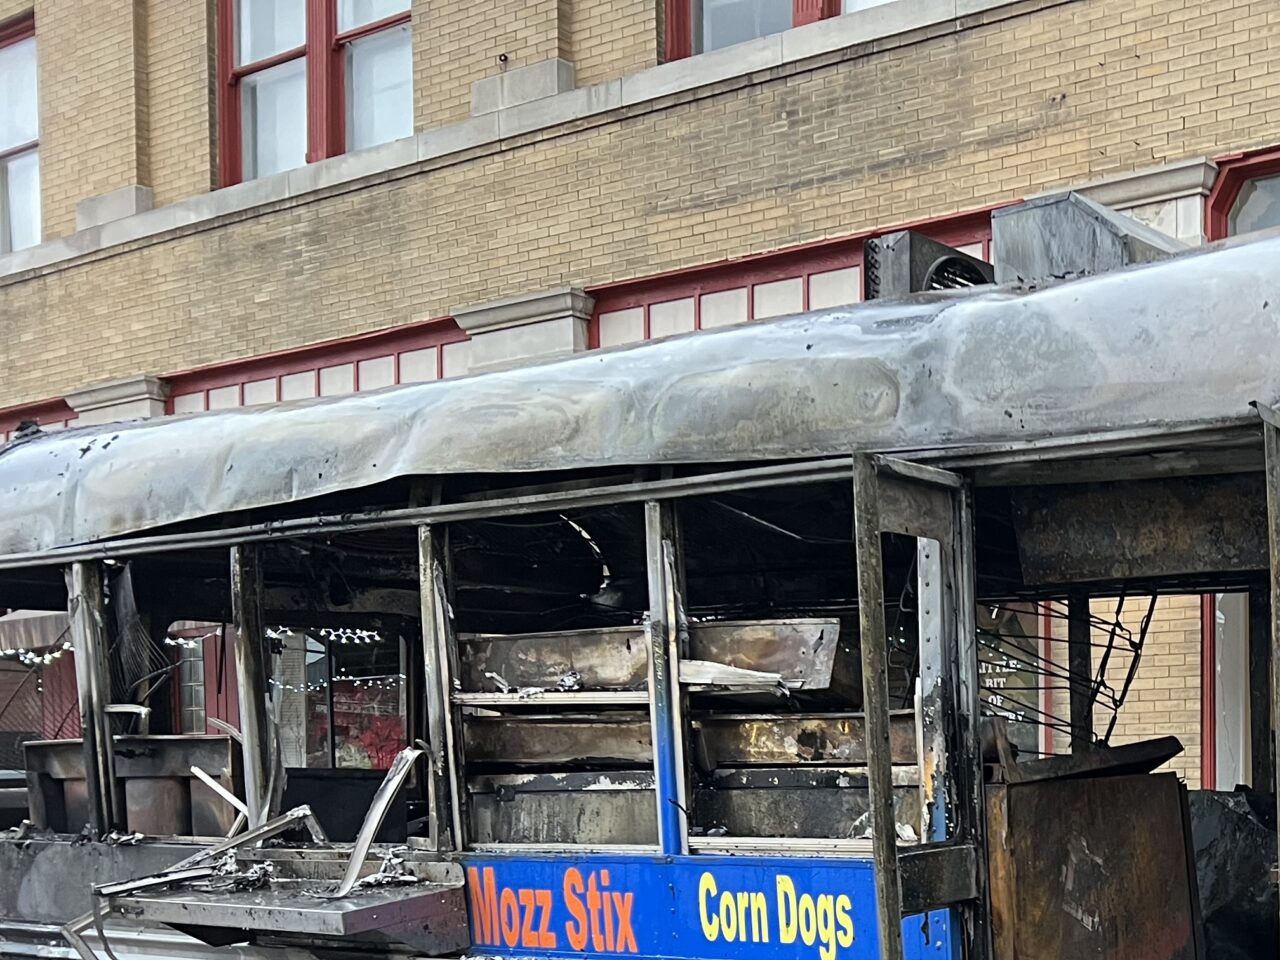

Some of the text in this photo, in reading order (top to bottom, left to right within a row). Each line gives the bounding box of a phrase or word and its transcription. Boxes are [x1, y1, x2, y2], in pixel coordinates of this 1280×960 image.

[468, 866, 639, 953] Mozz Stix
[698, 871, 769, 943] Corn
